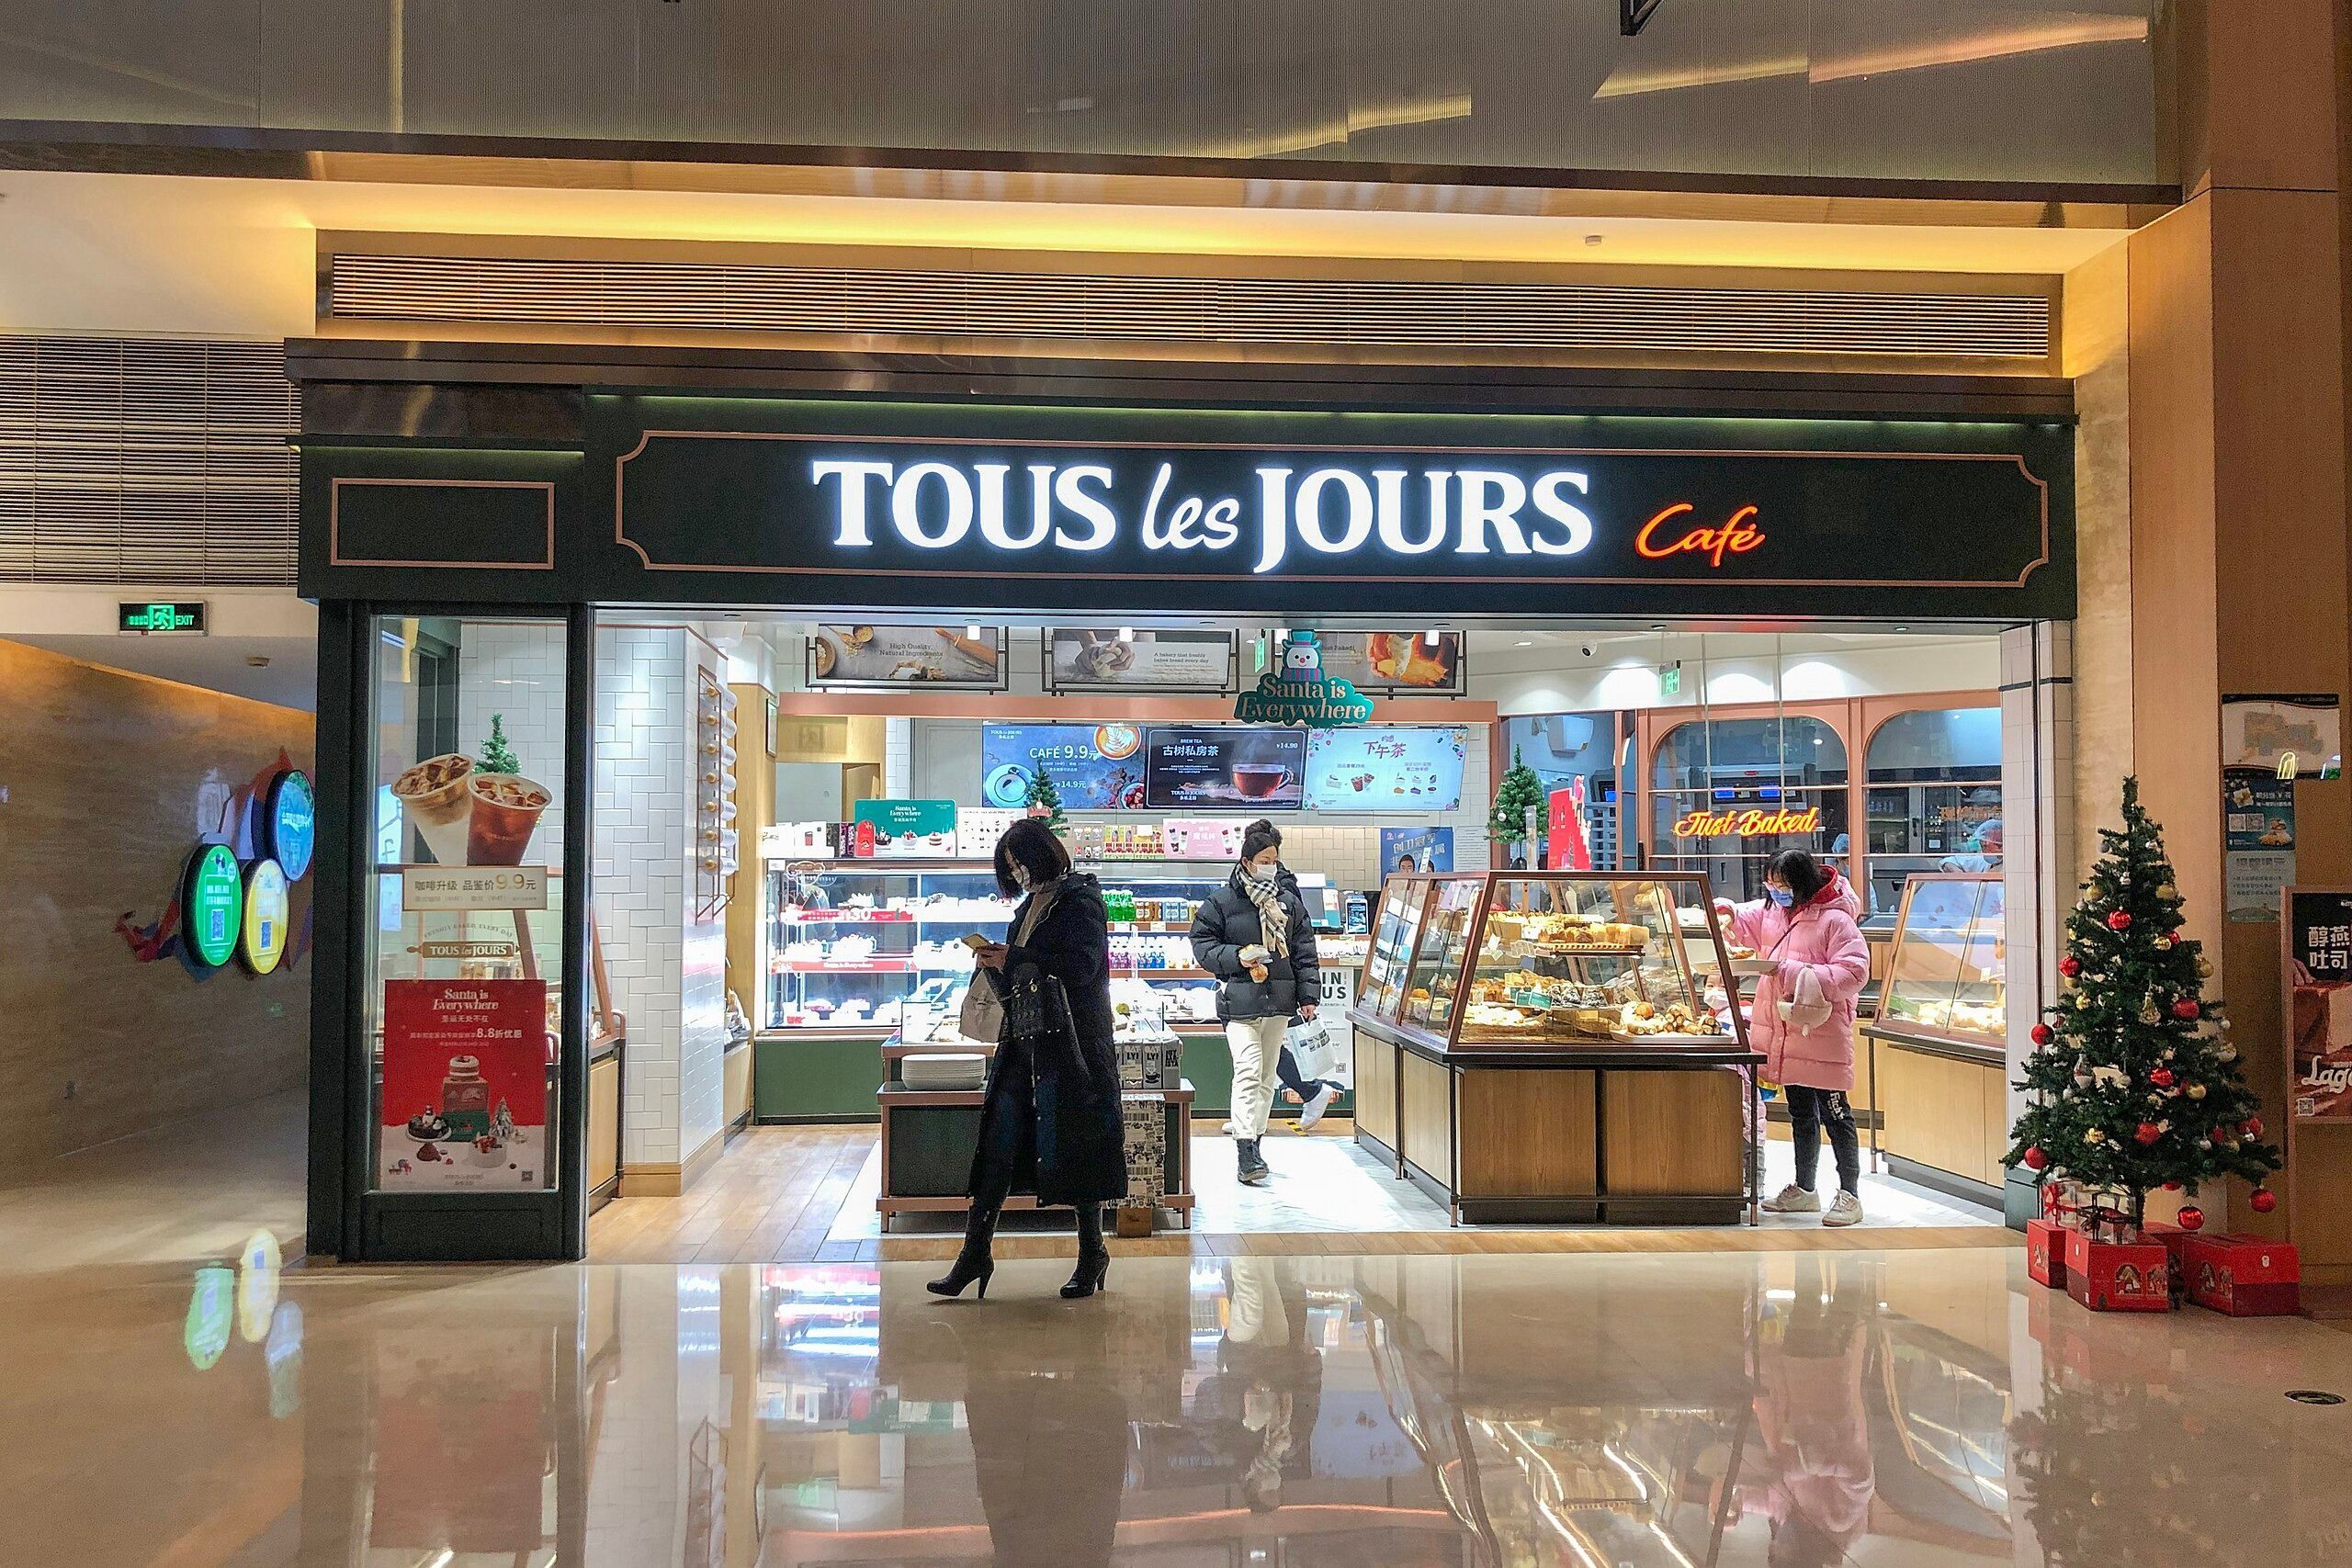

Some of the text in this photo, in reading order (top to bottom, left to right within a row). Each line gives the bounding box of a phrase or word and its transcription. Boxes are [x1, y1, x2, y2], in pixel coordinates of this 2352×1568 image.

[813, 461, 1765, 574] TOUS les JOURS Café
[175, 615, 194, 625] EXIT
[1262, 676, 1346, 699] Santa is
[1240, 697, 1366, 723] Everywhere
[1030, 746, 1060, 759] CAFÉ
[1162, 745, 1219, 757] 古树私房茶
[1363, 741, 1407, 759] 下午茶
[1674, 807, 1820, 838] Just Baked
[414, 880, 458, 891] 咖啡升级
[430, 946, 459, 955] TOUS
[472, 945, 507, 956] JOURS
[2309, 949, 2348, 969] 吐司
[445, 988, 489, 999] Santa is
[1322, 986, 1347, 999] US
[433, 998, 499, 1012] Everywhere
[1125, 1044, 1141, 1053] OAT
